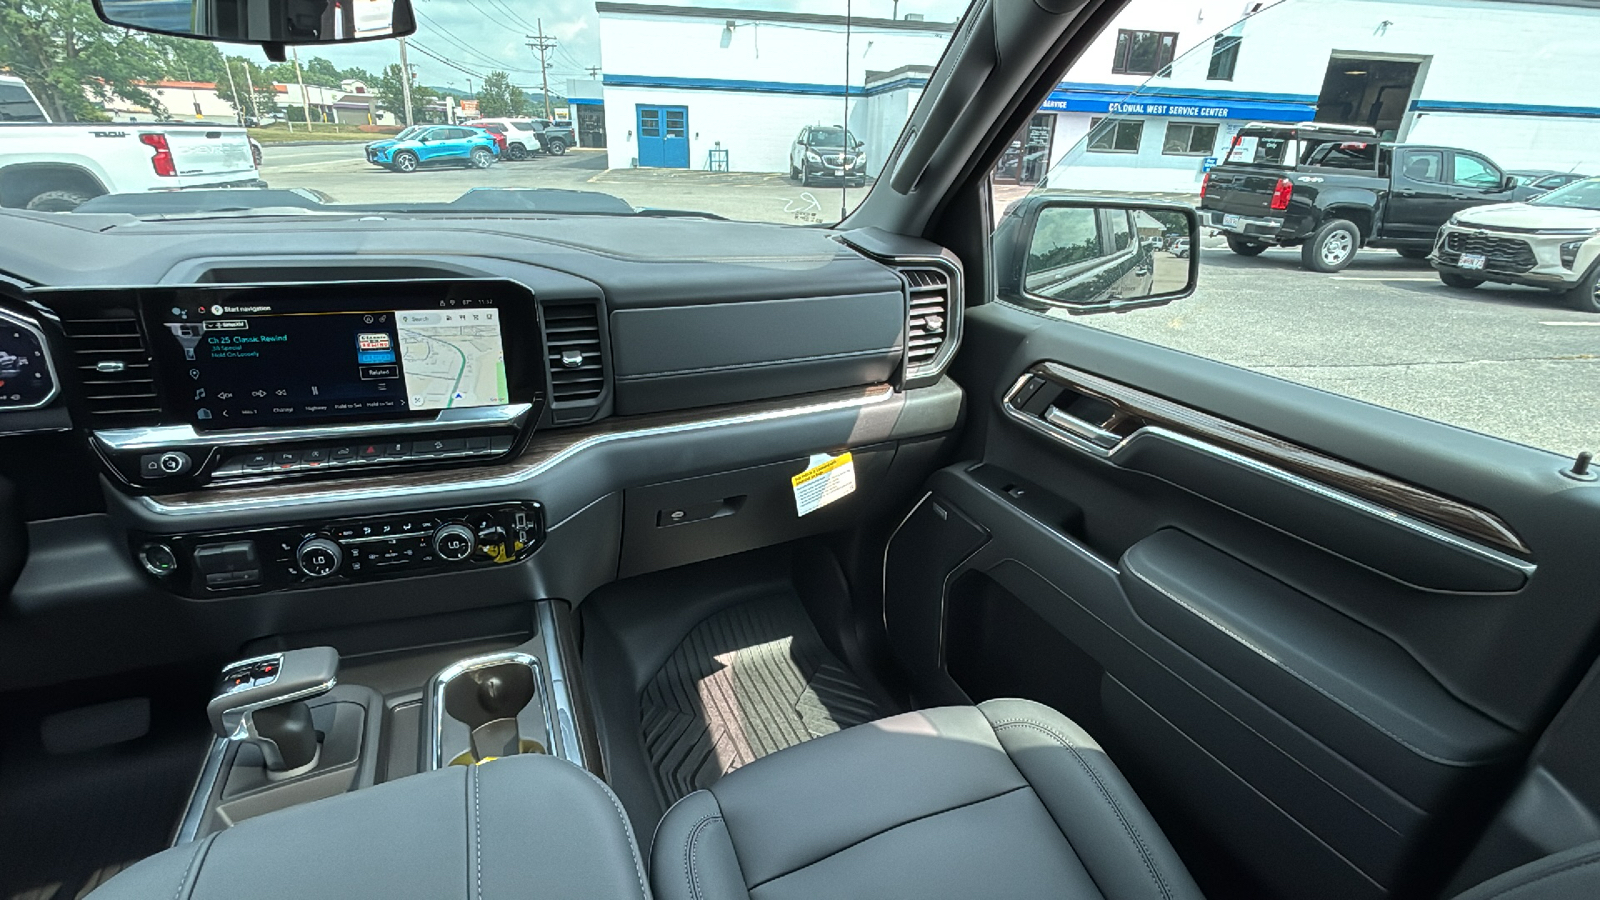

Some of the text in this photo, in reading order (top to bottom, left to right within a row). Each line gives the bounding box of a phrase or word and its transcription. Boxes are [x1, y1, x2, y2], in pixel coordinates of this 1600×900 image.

[1109, 102, 1229, 117] COLONIAL WEST SERVICE CENTER
[224, 305, 271, 313] Start navigation
[221, 336, 231, 344] 25
[260, 334, 288, 342] Rewind
